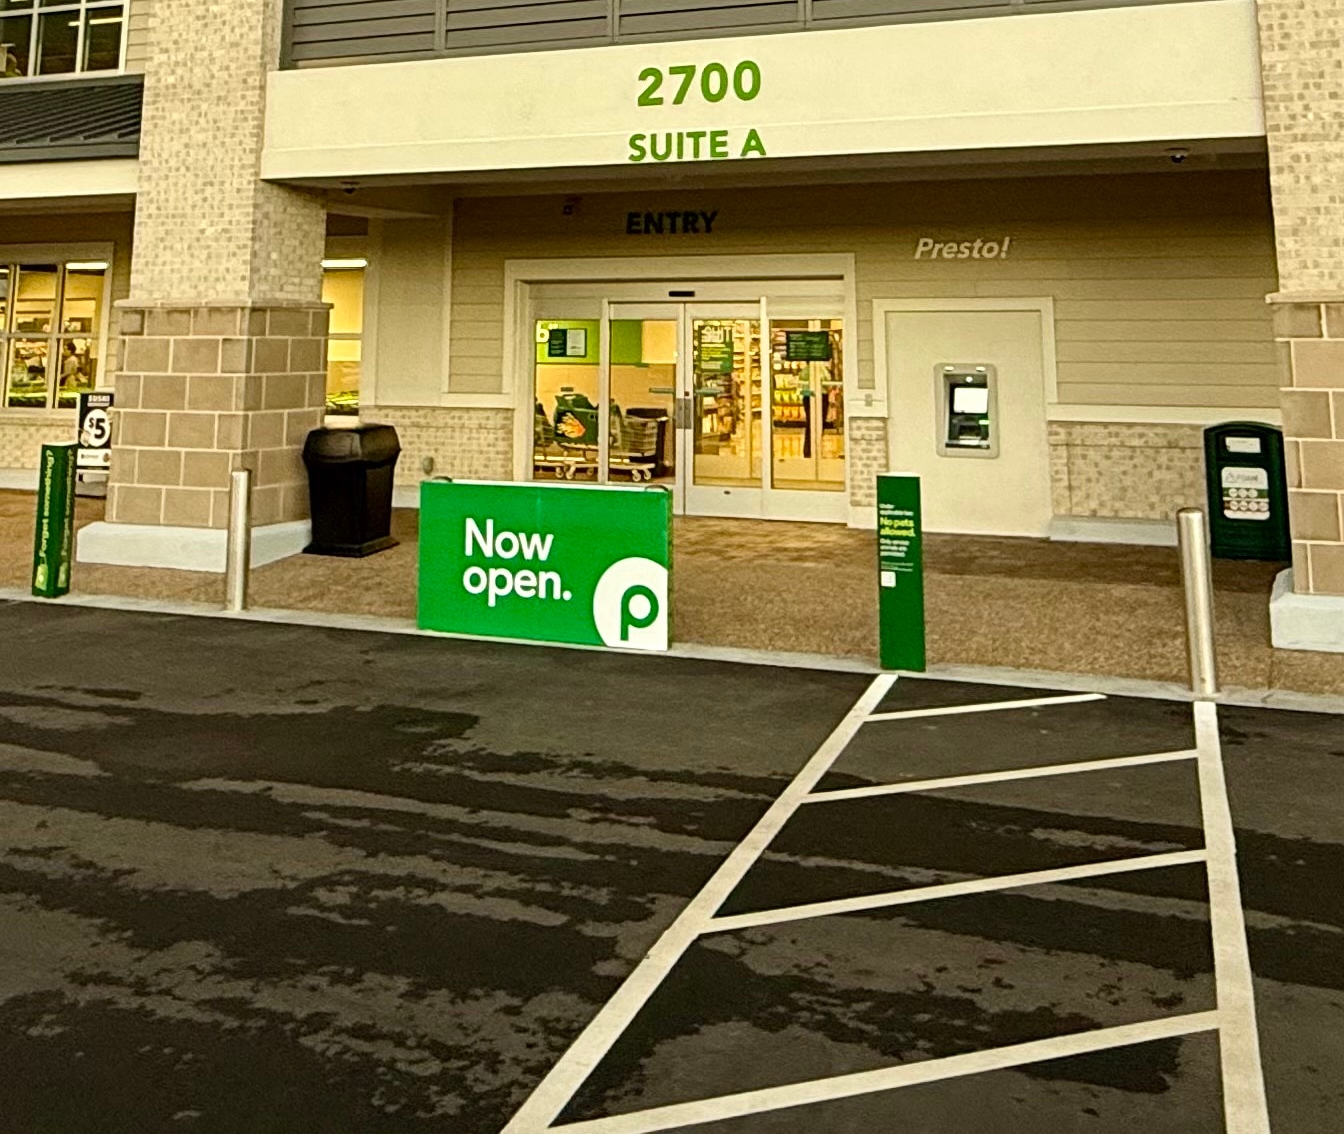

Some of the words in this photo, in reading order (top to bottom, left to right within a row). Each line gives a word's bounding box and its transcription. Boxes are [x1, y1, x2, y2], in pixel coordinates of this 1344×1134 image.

[637, 60, 762, 107] 2700
[628, 130, 729, 162] SUITE
[740, 128, 767, 157] A
[626, 209, 719, 235] ENTRY
[914, 236, 1010, 260] Presto!
[88, 416, 106, 440] $5
[43, 449, 55, 517] something?
[39, 518, 50, 557] Forget
[464, 517, 554, 561] Now
[880, 517, 893, 526] No
[893, 519, 914, 529] pets
[462, 566, 572, 607] open.
